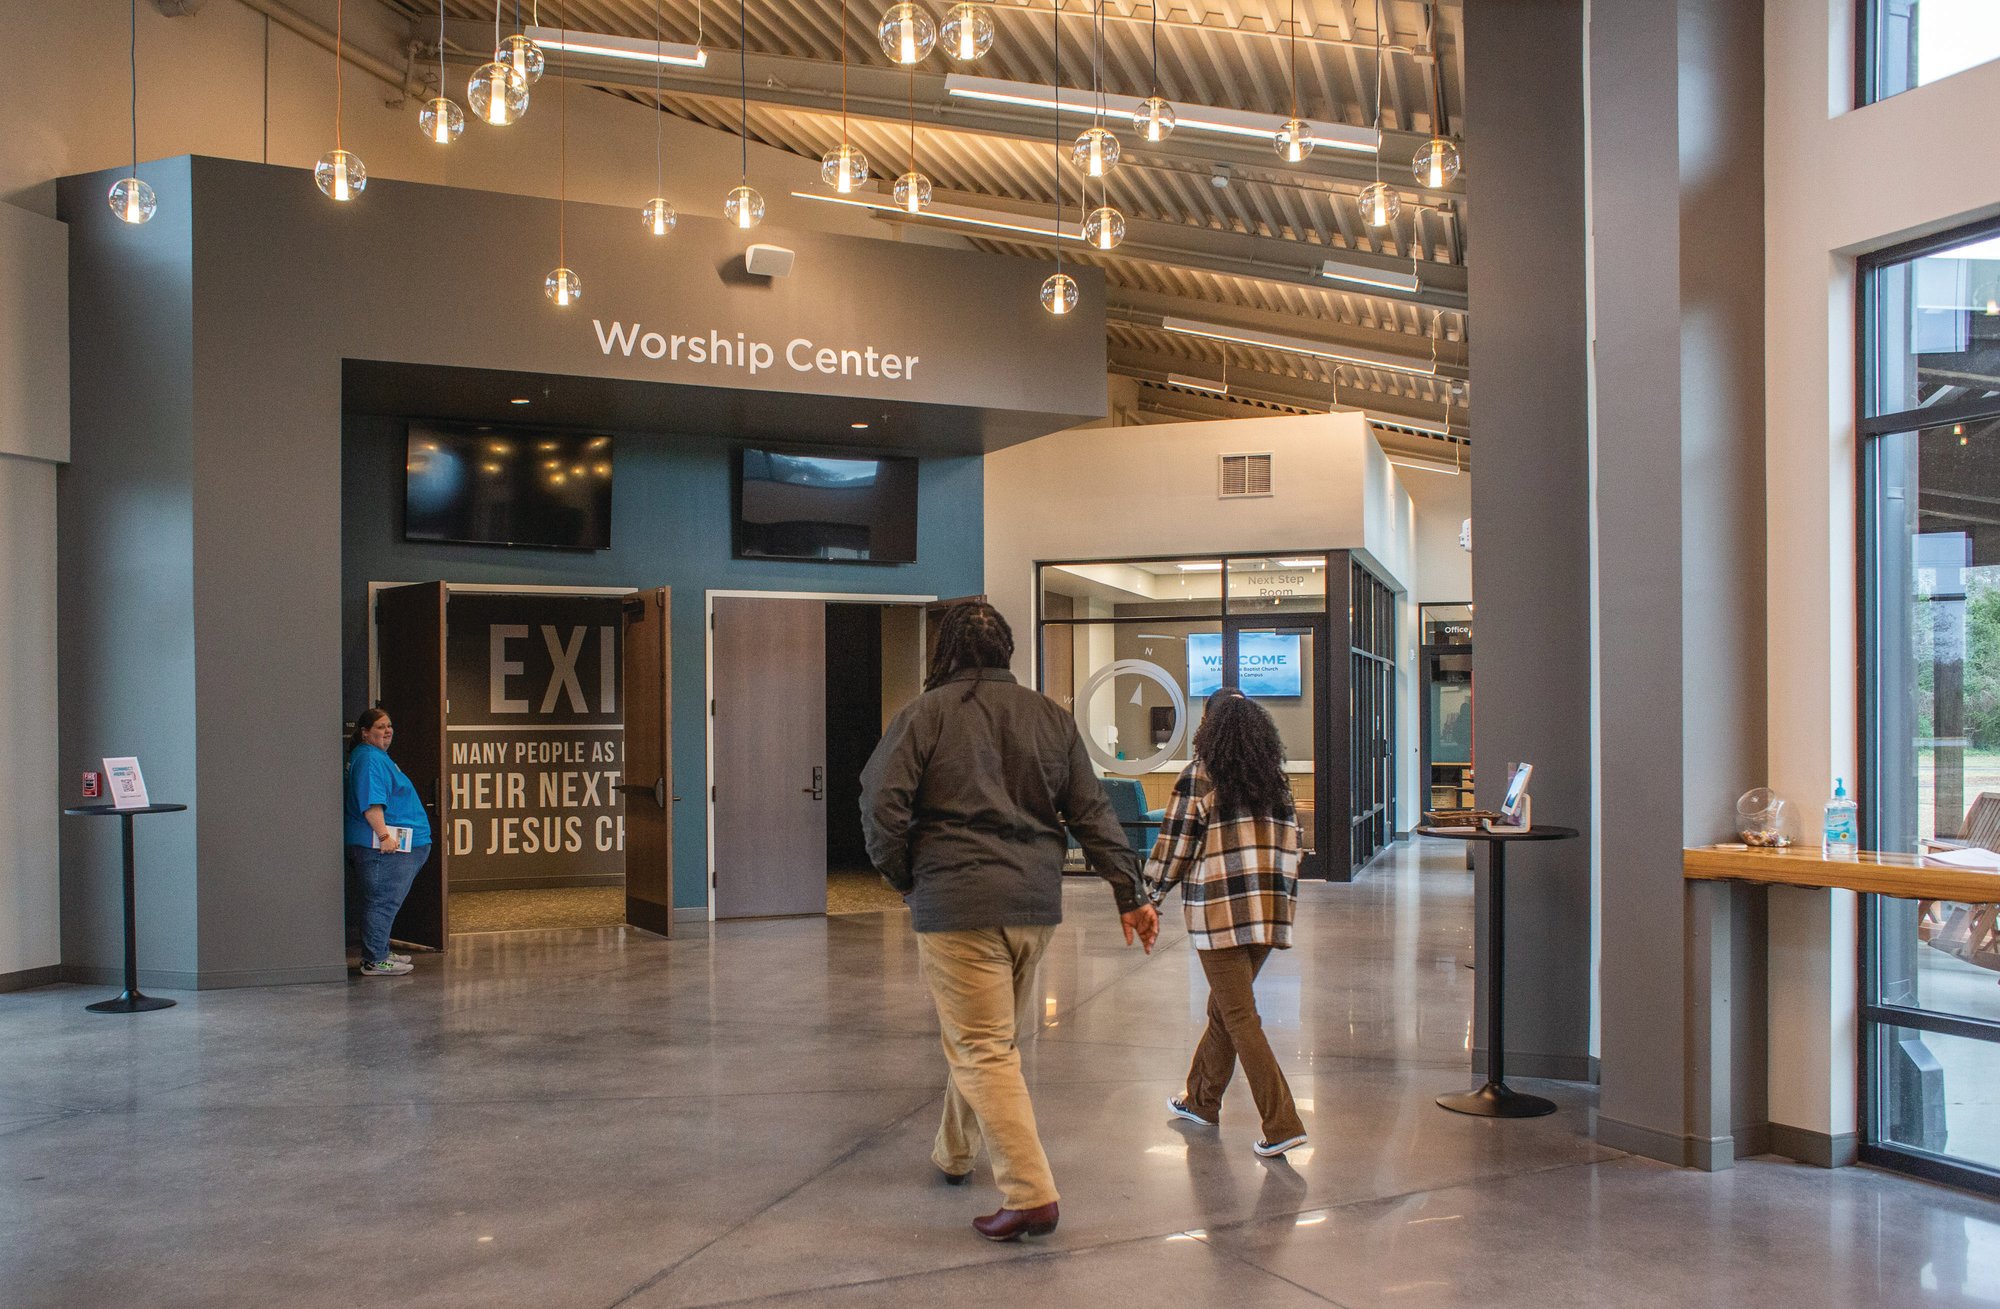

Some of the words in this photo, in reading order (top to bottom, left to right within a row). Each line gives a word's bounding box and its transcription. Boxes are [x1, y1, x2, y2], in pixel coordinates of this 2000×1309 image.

[592, 319, 774, 374] Worship
[786, 338, 919, 380] Center
[1248, 576, 1274, 585] Next
[1278, 574, 1304, 585] Step
[1259, 588, 1293, 597] Room
[1444, 626, 1469, 634] Office
[1144, 647, 1153, 656] N
[1063, 695, 1074, 704] W
[452, 742, 509, 765] MANY
[515, 741, 585, 764] PEOPLE
[591, 741, 615, 763] AS
[539, 771, 621, 807] NEXT
[447, 818, 473, 856] D
[486, 816, 583, 855] JESUS
